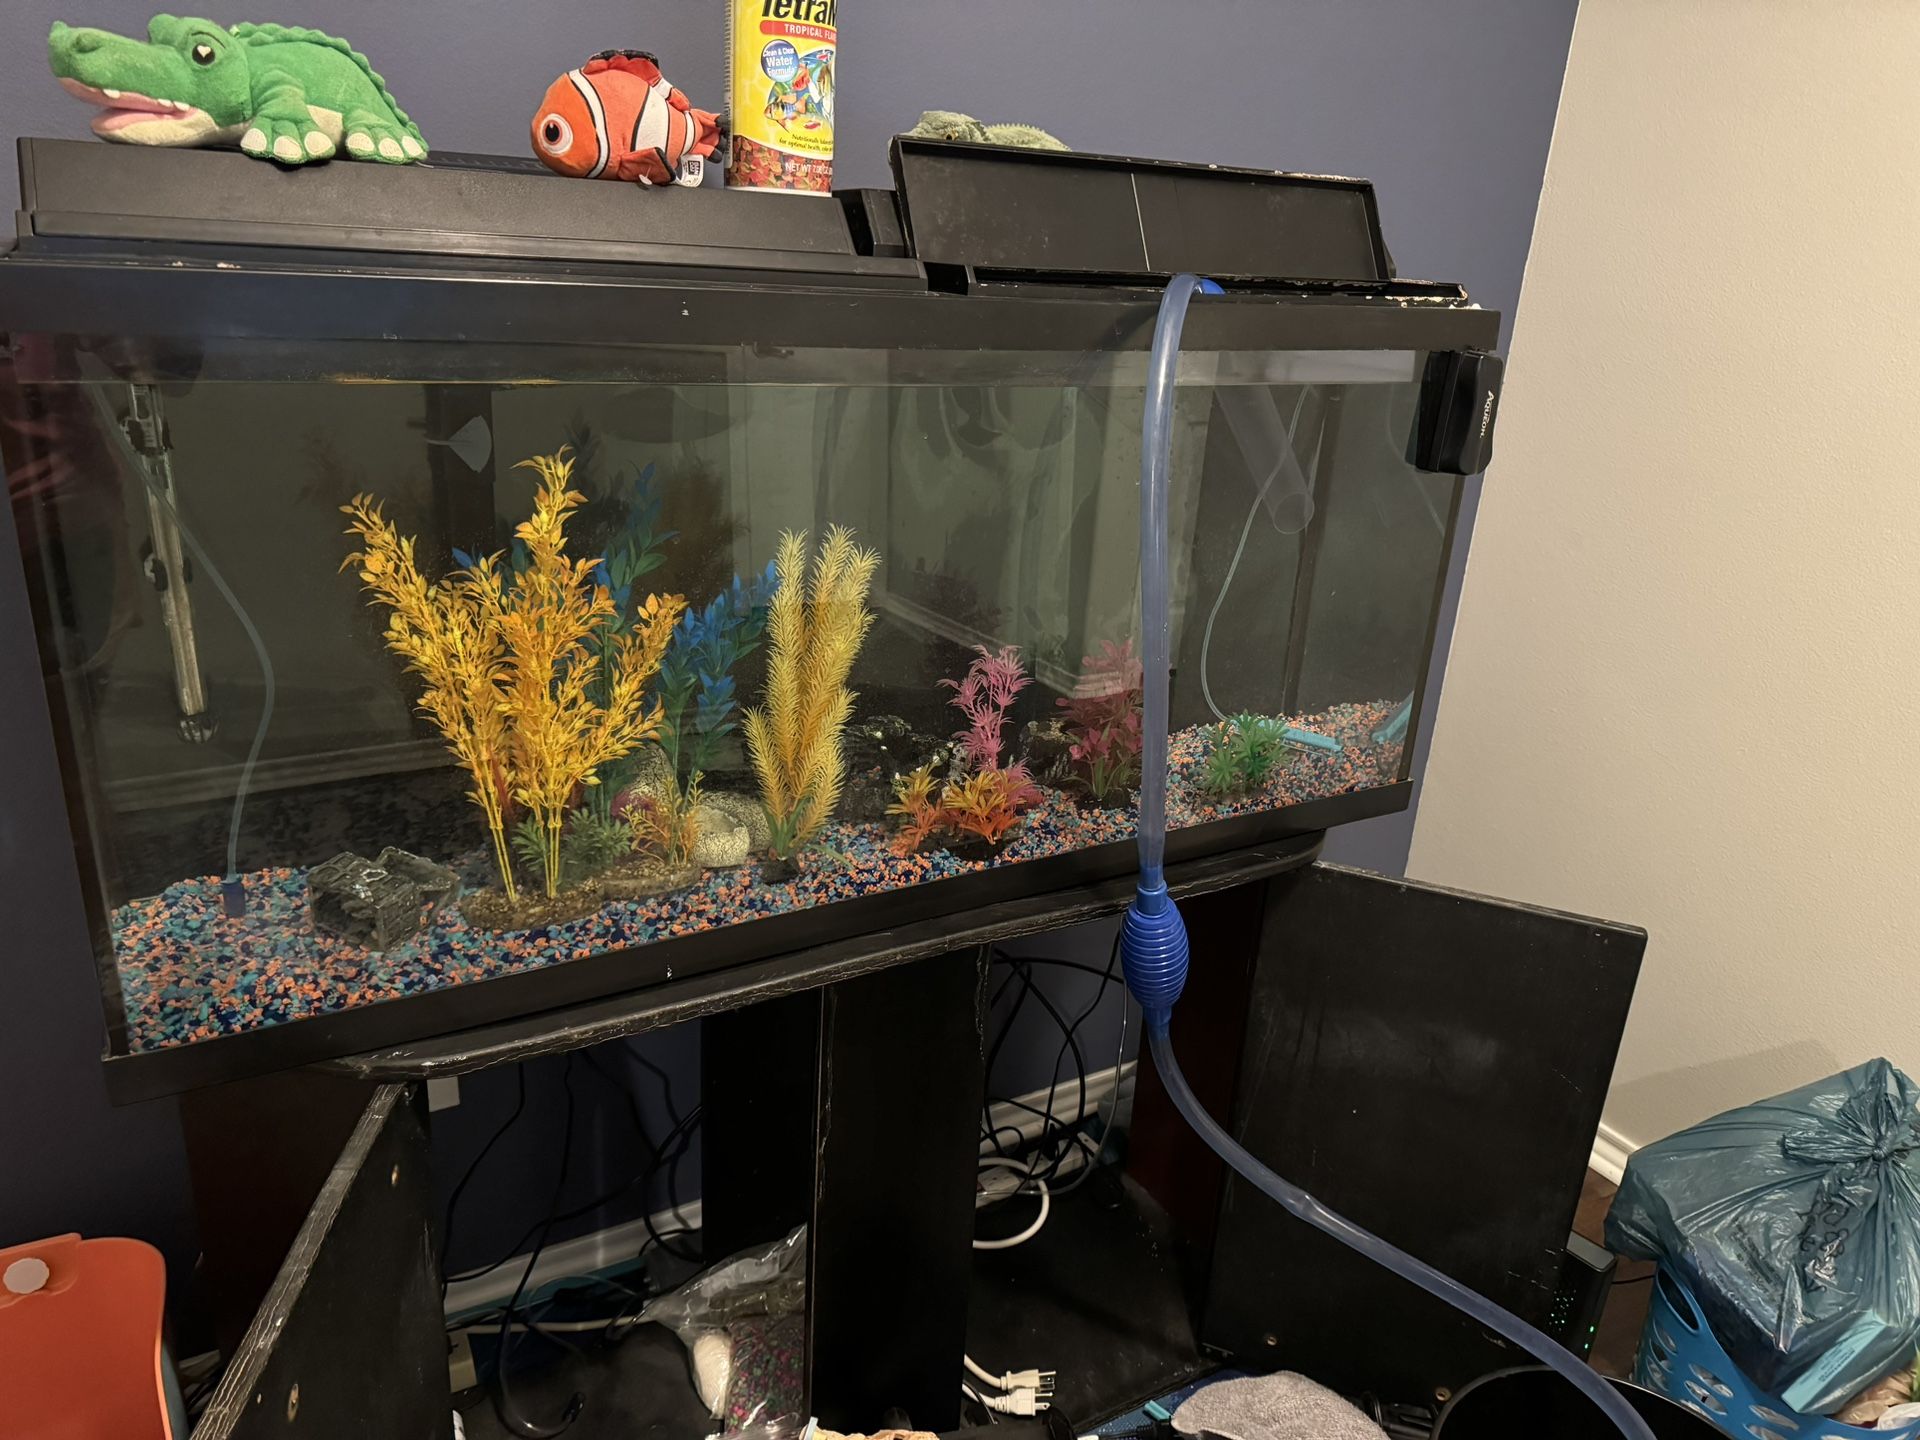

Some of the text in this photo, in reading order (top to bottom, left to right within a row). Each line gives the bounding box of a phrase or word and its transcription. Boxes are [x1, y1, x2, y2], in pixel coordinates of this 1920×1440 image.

[784, 23, 824, 37] TROPICAL
[778, 48, 783, 56] &
[766, 57, 793, 67] Water
[785, 162, 800, 172] NET
[801, 164, 811, 173] WT
